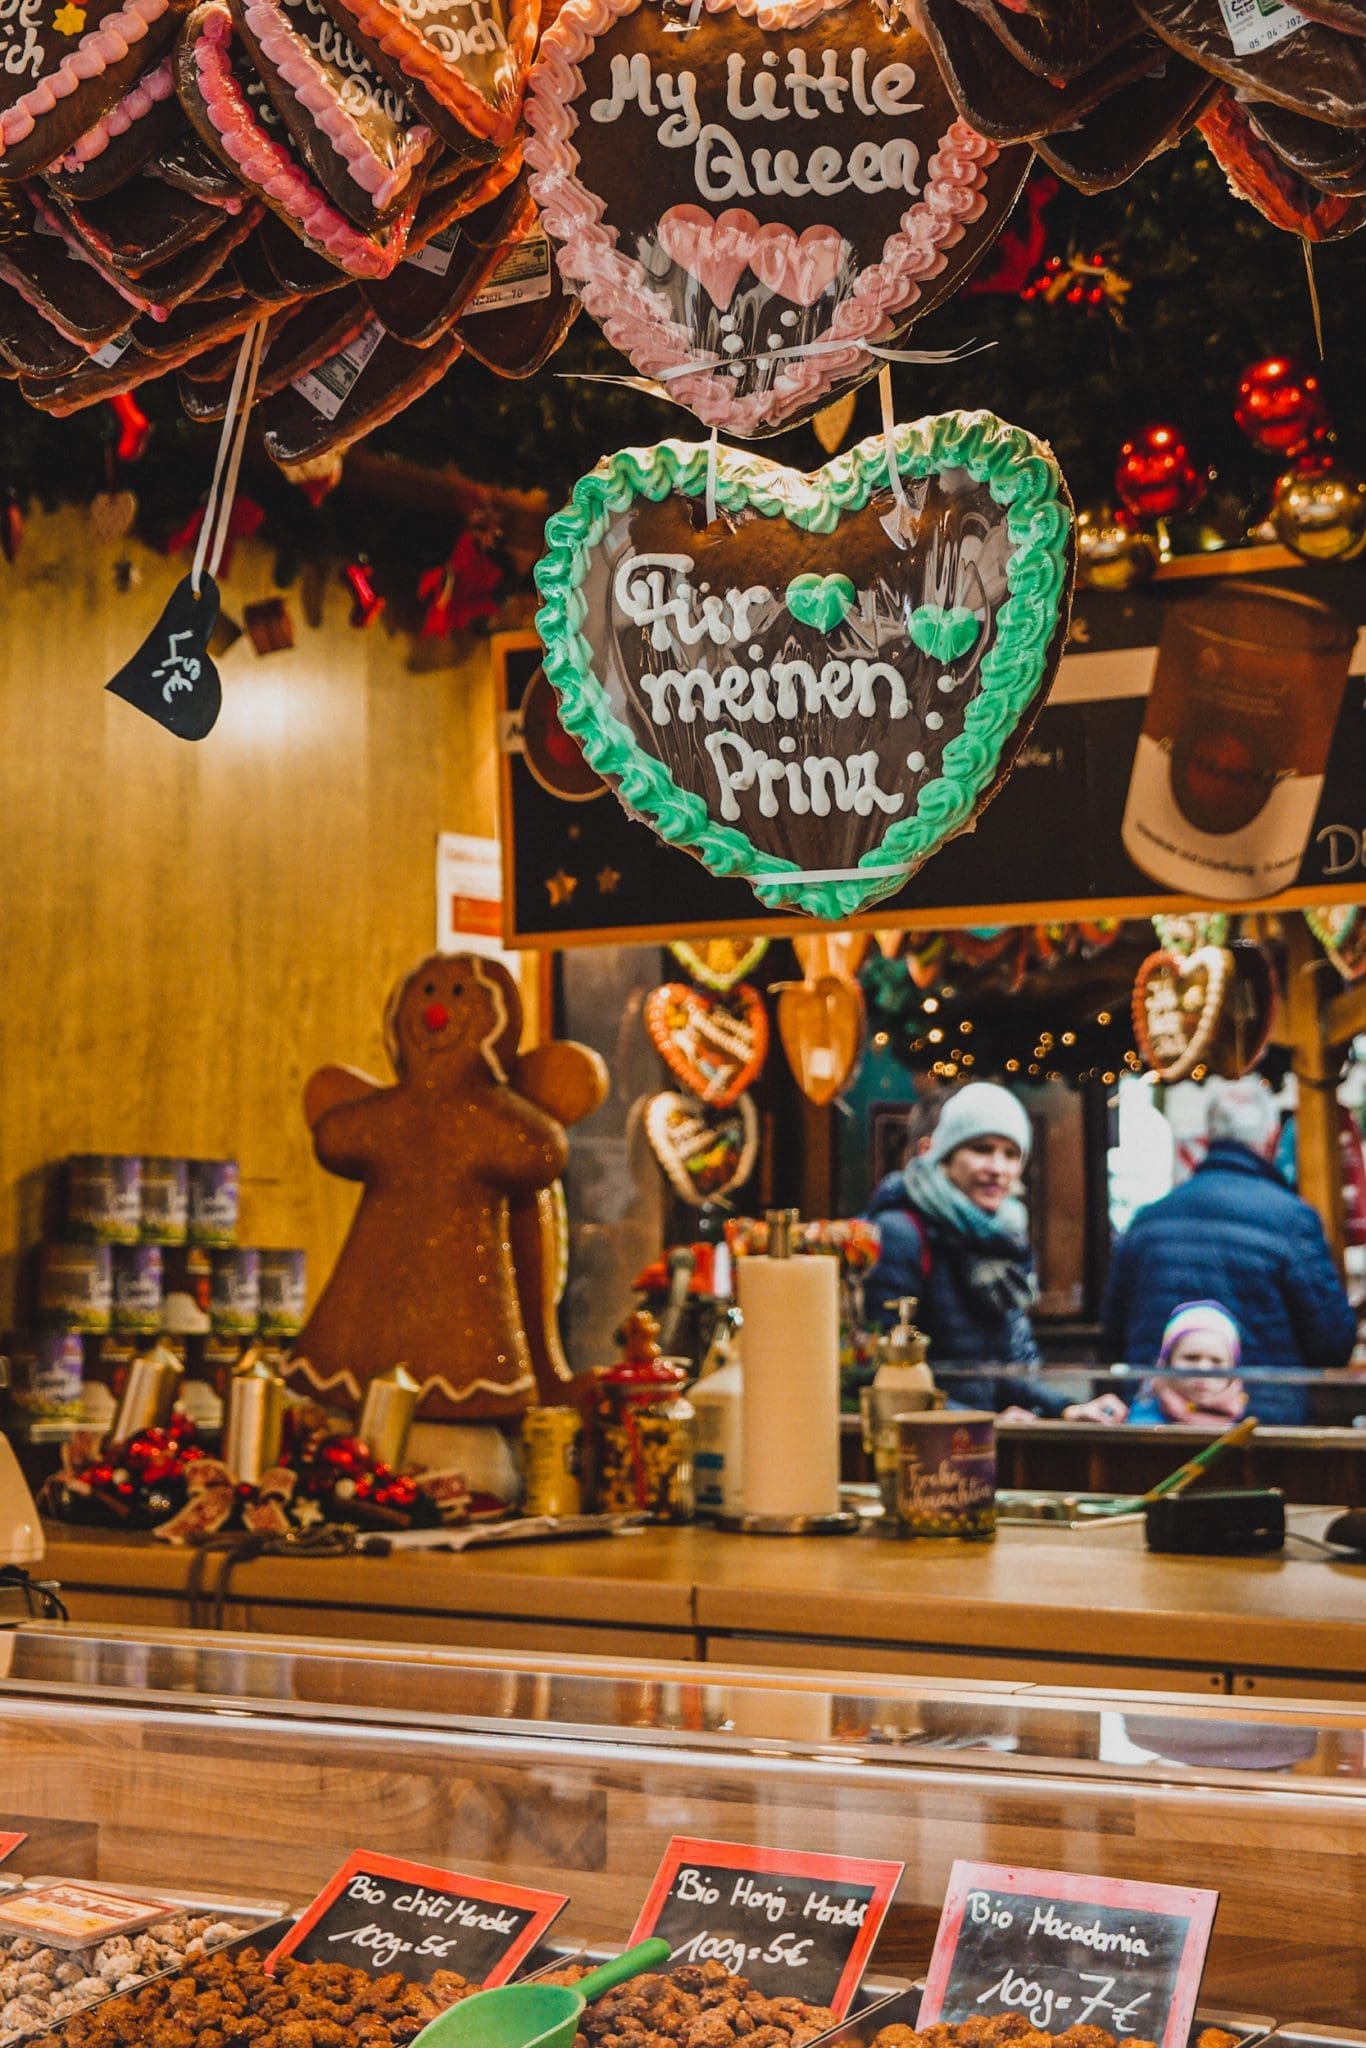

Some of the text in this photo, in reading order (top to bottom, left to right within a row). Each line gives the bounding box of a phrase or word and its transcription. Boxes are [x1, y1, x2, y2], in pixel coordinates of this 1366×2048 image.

[424, 1, 509, 63] Dich
[590, 52, 701, 148] My
[695, 124, 921, 201] Queen
[615, 553, 770, 651] Für
[640, 644, 912, 726] meinen
[704, 730, 904, 821] Prinz
[348, 1875, 387, 1905] Bio
[676, 1869, 720, 1905] Bio
[729, 1876, 787, 1922] Honig
[967, 1891, 1150, 1957] Bio Macadamia
